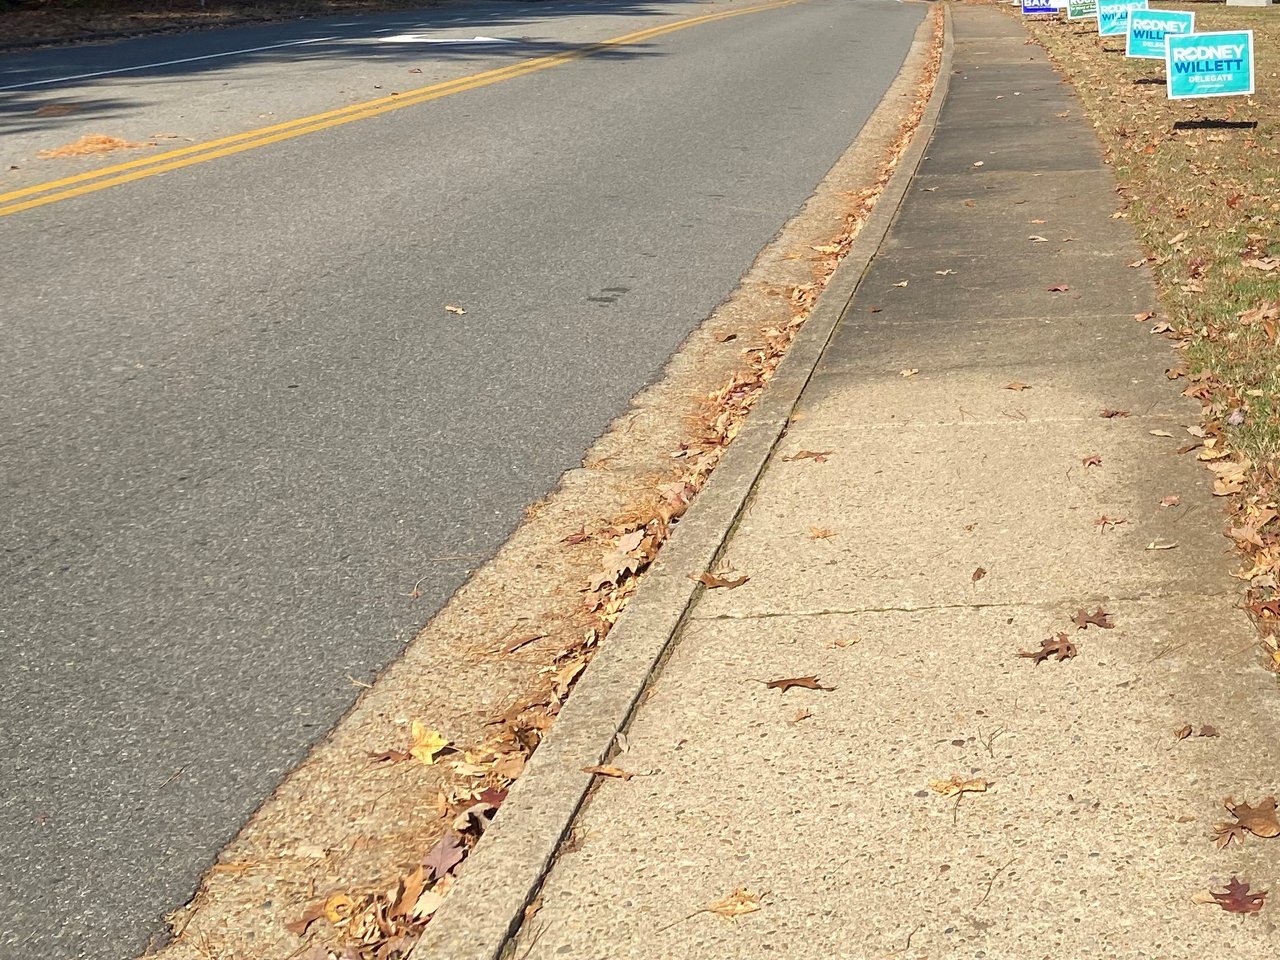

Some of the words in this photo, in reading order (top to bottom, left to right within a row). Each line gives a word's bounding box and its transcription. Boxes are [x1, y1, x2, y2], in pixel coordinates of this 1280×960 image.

[1133, 19, 1188, 32] RODNEY
[1172, 43, 1246, 62] RODNEY
[1174, 59, 1243, 74] WILLETT
[1188, 73, 1234, 84] DELEGATE
